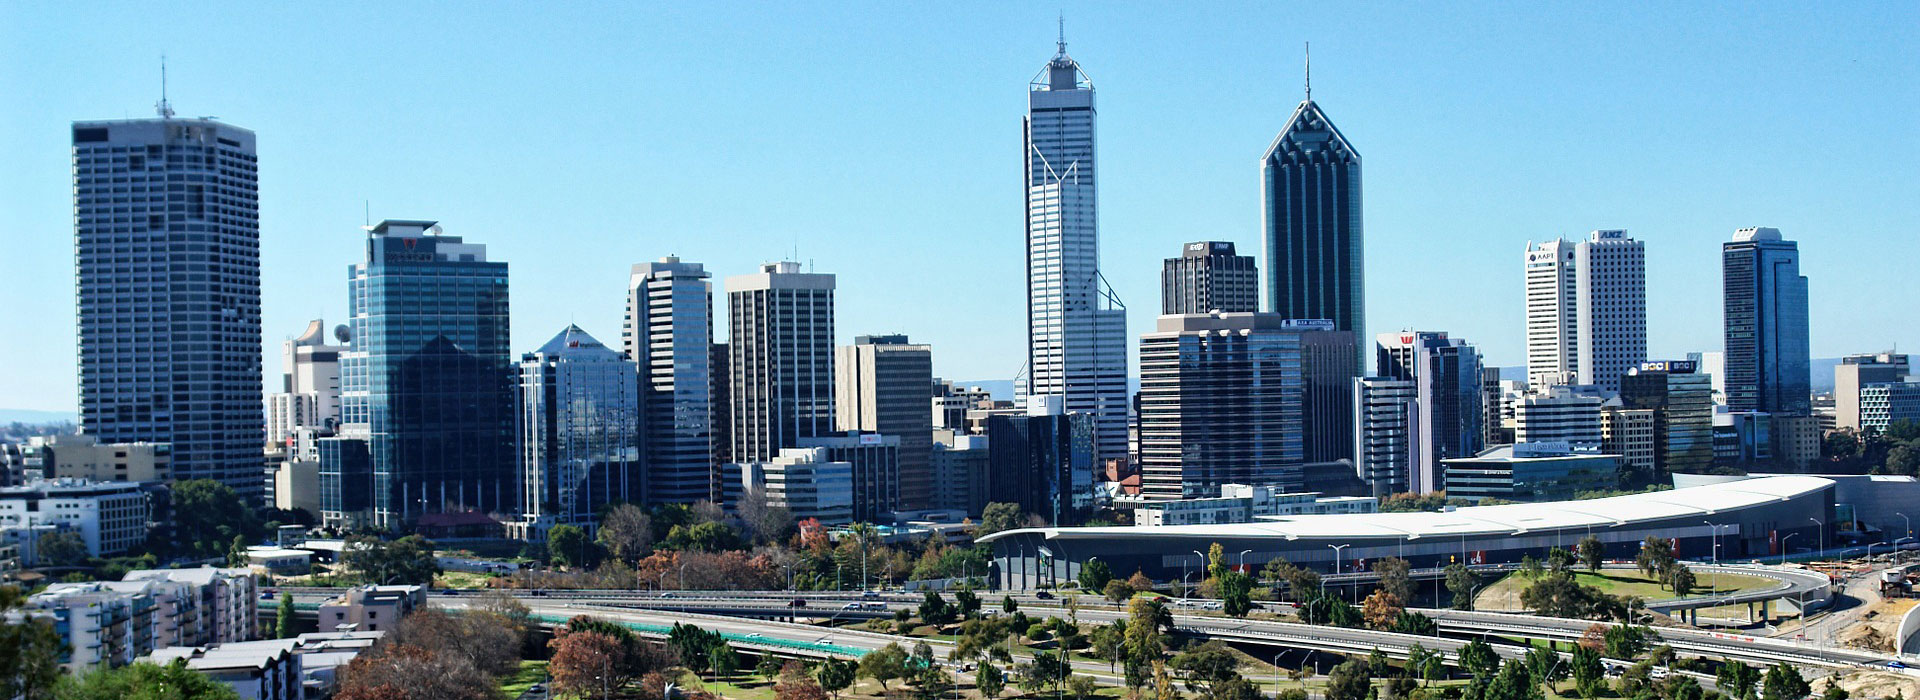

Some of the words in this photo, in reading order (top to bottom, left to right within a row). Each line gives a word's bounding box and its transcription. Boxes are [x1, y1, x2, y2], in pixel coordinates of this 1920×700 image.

[1600, 230, 1623, 239] ANZ
[1537, 252, 1554, 260] AAPT
[1670, 537, 1676, 550] 2
[1475, 550, 1482, 565] 4
[1359, 558, 1365, 572] 5
